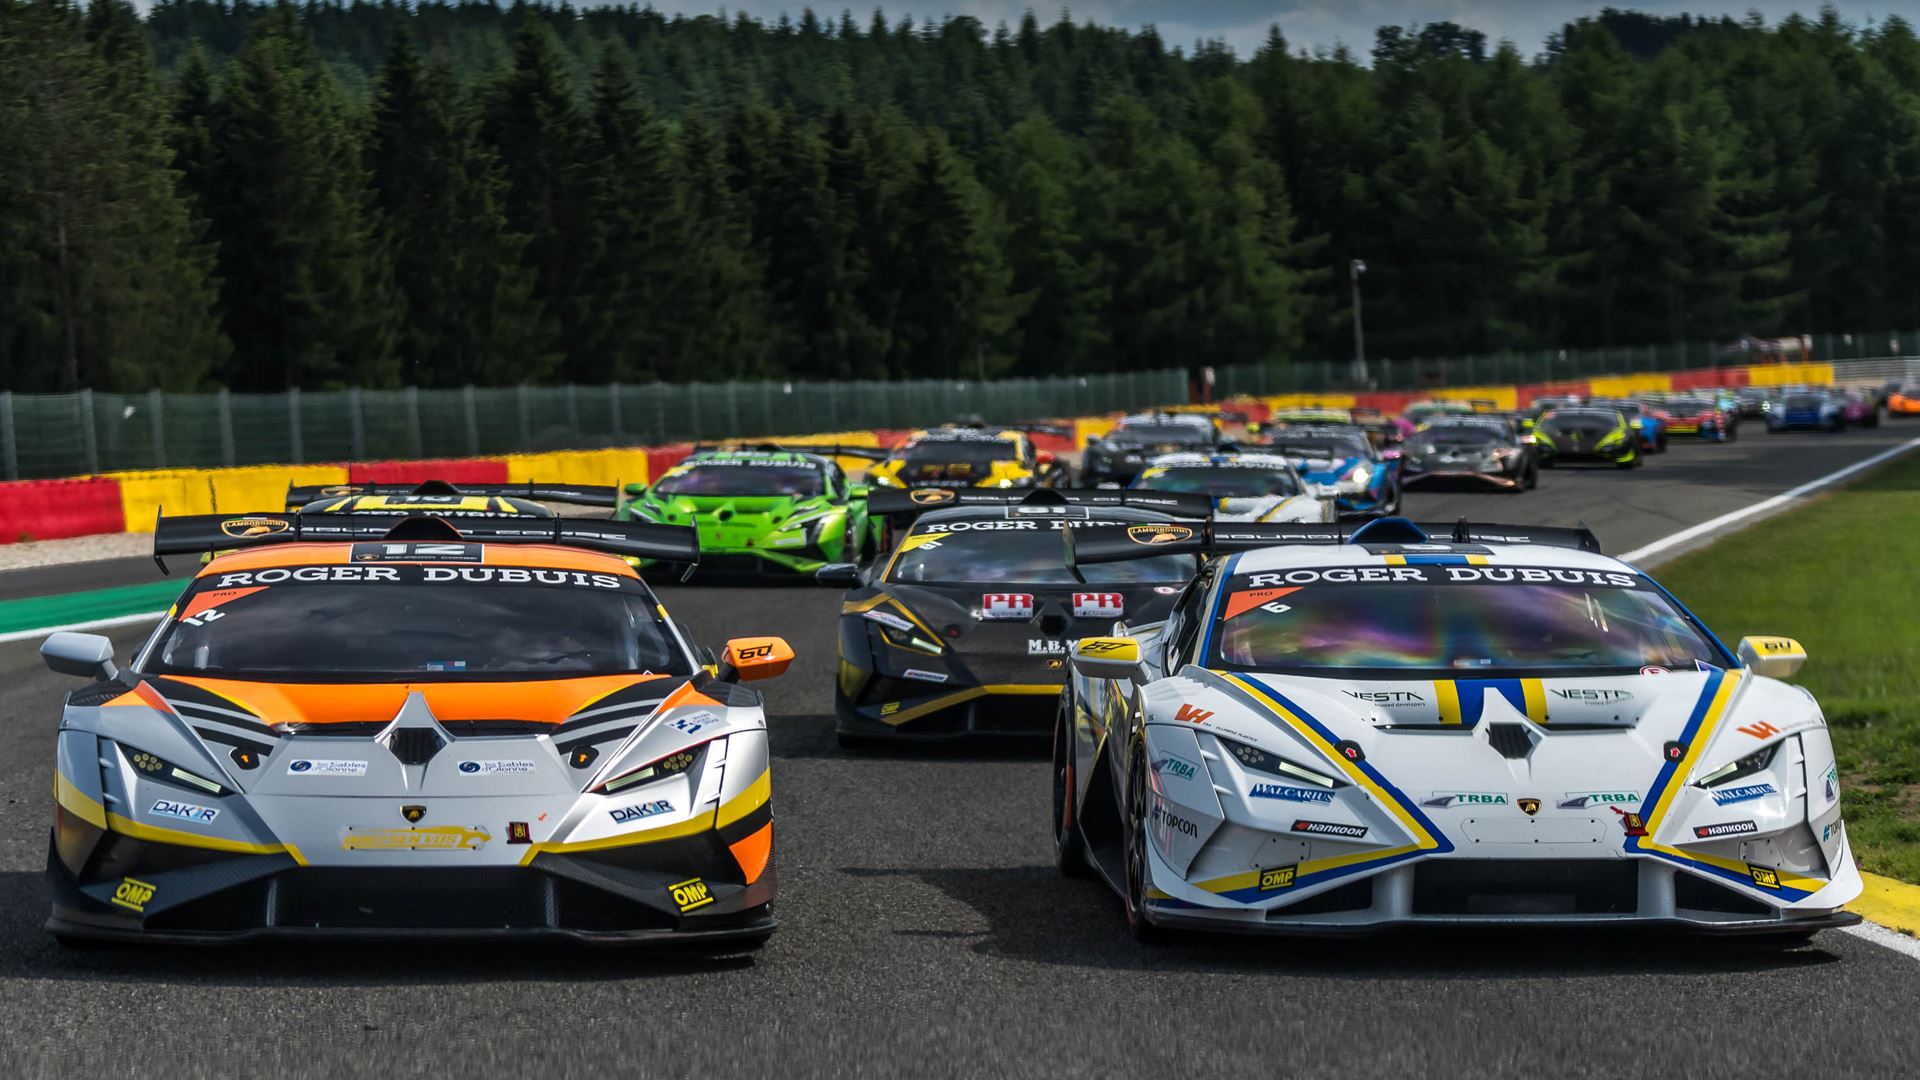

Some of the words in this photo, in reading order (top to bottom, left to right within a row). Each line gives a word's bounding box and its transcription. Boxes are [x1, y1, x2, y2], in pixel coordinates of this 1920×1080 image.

[925, 521, 1038, 533] ROGER
[382, 543, 465, 555] 12
[217, 566, 400, 588] ROGER
[423, 567, 621, 589] DUBUIS
[1249, 567, 1428, 587] ROGER
[1445, 567, 1636, 588] DUBUIS
[984, 594, 1033, 609] PR
[1074, 593, 1122, 608] PR
[1260, 601, 1292, 613] 6
[182, 608, 226, 627] 12
[737, 644, 773, 660] 60
[1341, 690, 1424, 702] VESTA
[1167, 758, 1196, 778] TRBA
[1255, 783, 1335, 801] WALCARIUS
[1455, 794, 1507, 804] TRBA
[1589, 793, 1639, 804] TRBA
[1712, 785, 1775, 801] WALCARIUS
[1162, 810, 1198, 838] TOPCON
[1263, 871, 1294, 887] OMP
[1753, 870, 1776, 885] OMP
[116, 881, 153, 906] OMP
[673, 880, 707, 906] OMP
